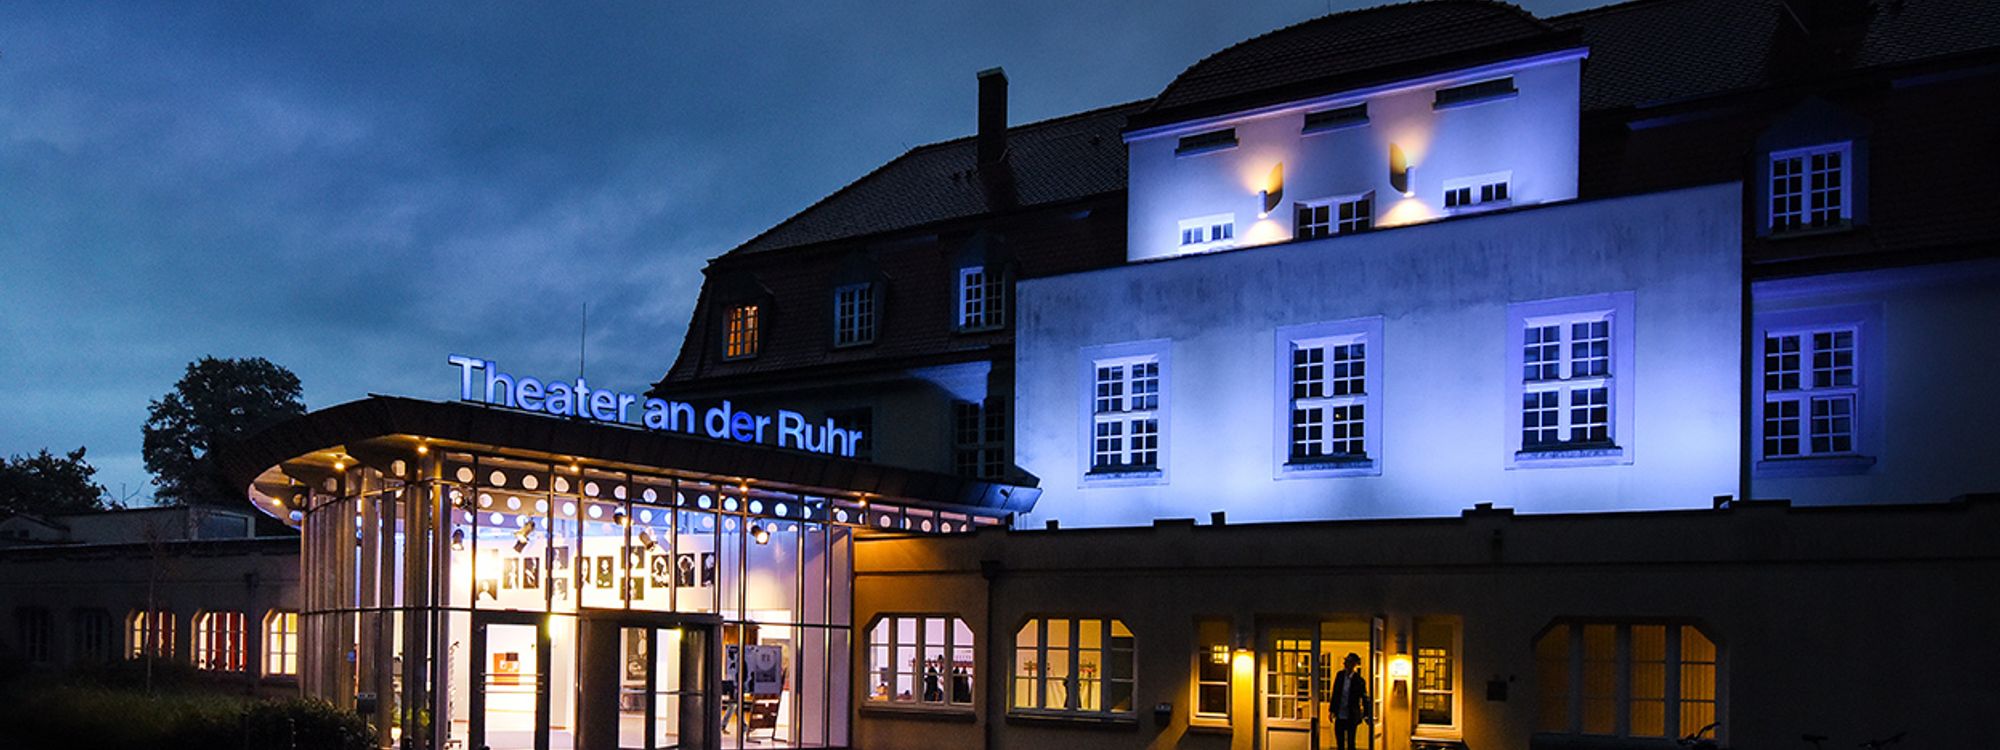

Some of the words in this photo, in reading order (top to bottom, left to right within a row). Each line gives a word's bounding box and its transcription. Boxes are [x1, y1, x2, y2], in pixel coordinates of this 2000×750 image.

[449, 354, 635, 424] Theater
[644, 396, 695, 433] an
[705, 400, 770, 443] der
[777, 409, 862, 457] Ruhr
